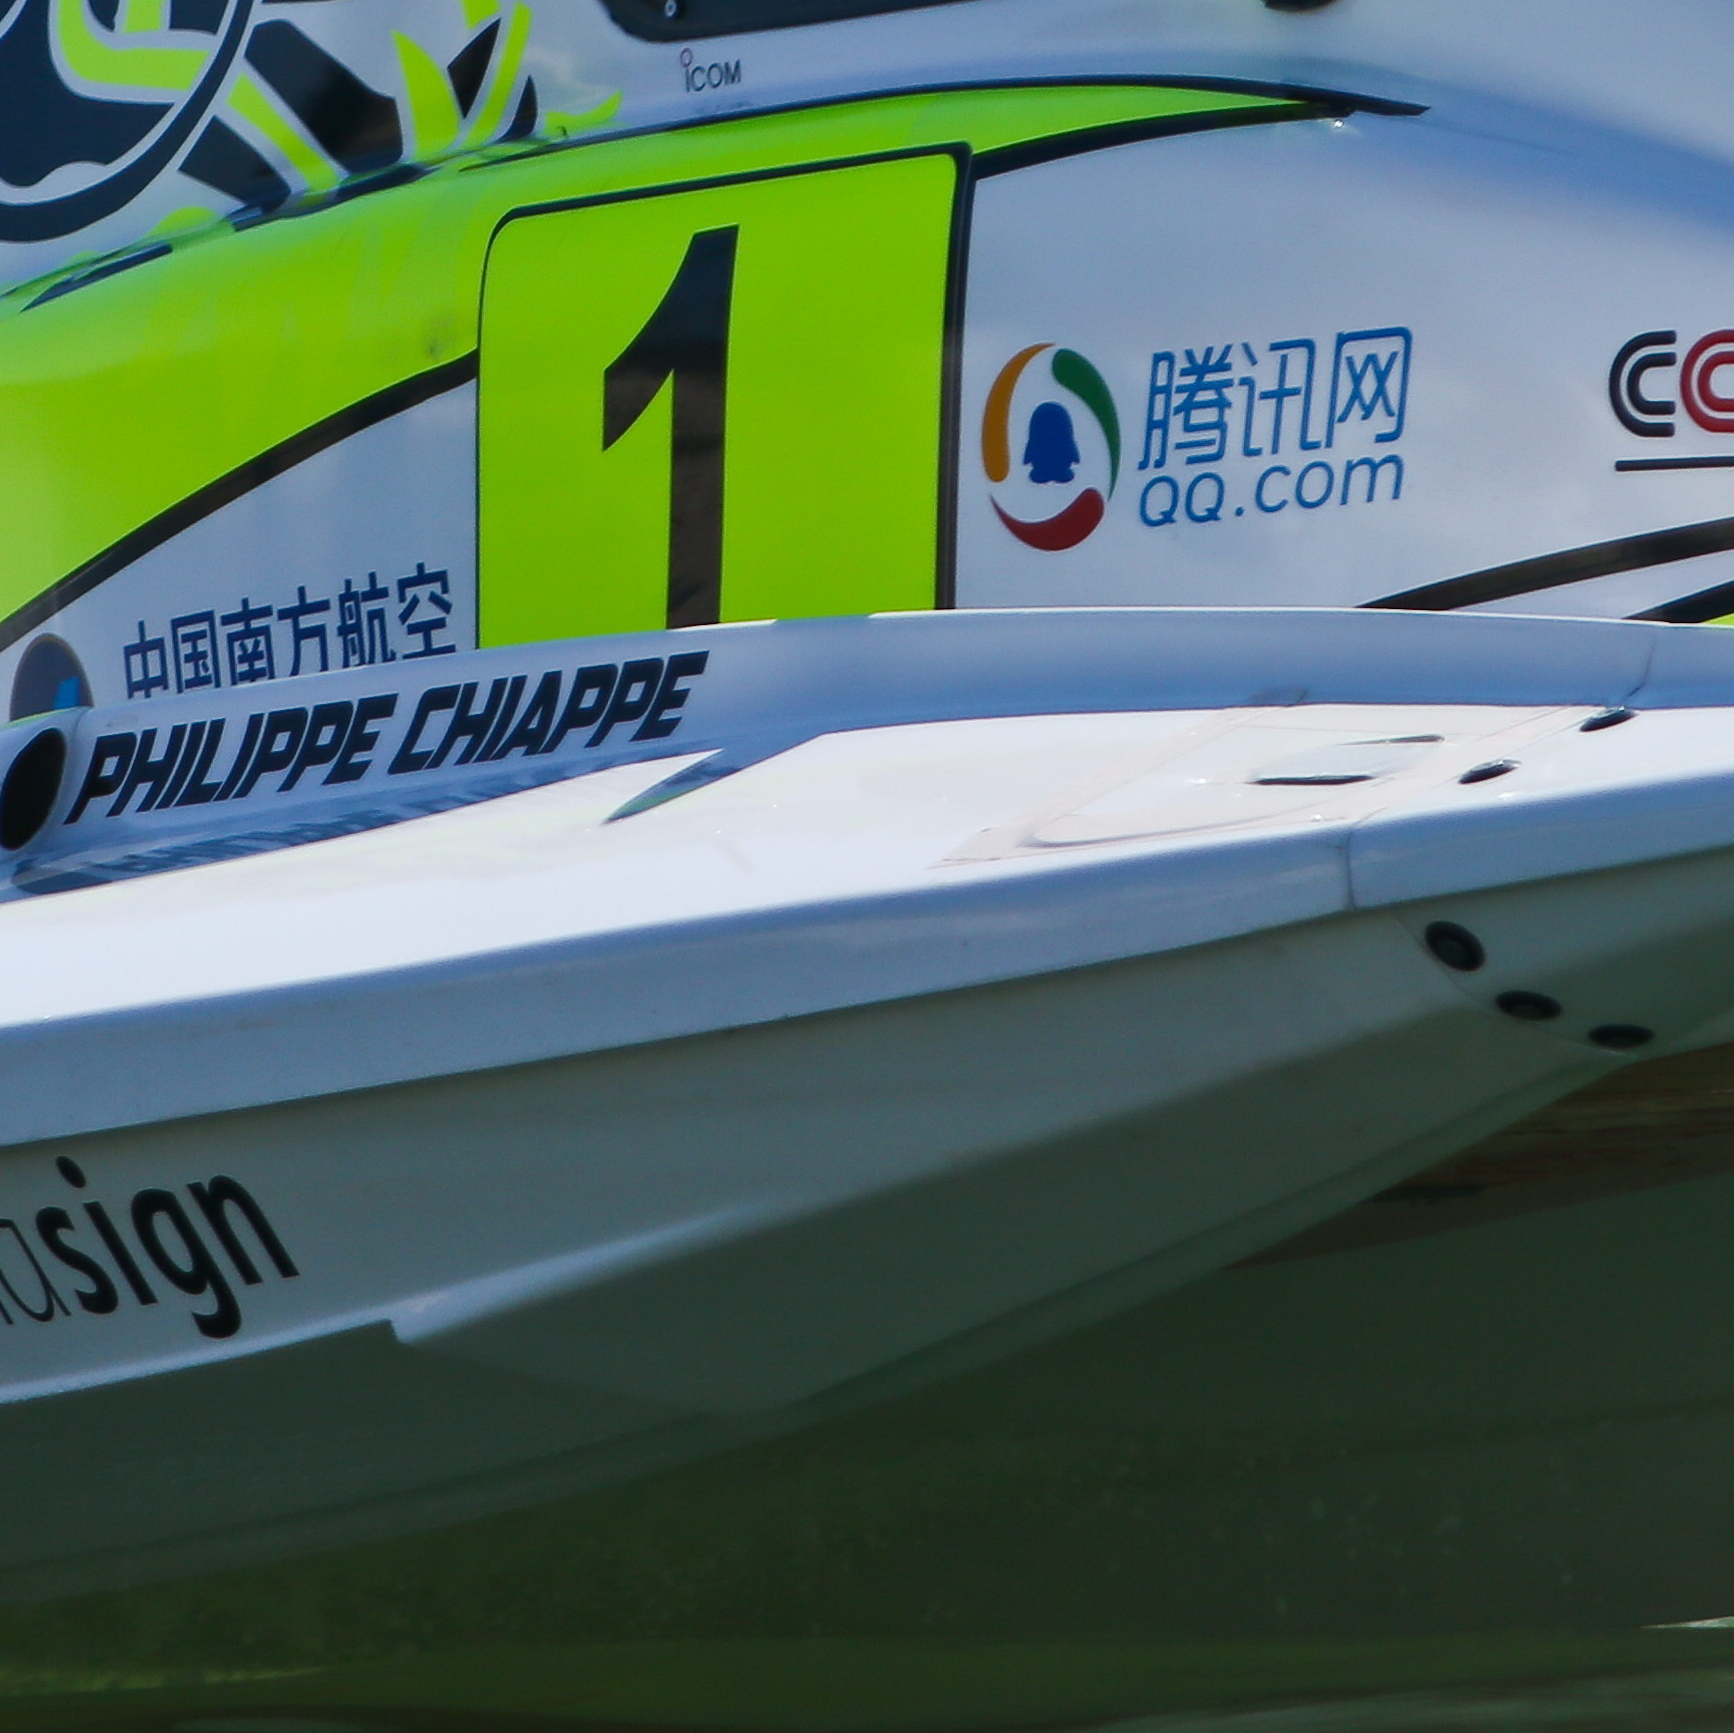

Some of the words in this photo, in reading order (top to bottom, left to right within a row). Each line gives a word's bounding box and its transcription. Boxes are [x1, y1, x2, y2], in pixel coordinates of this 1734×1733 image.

[604, 223, 739, 629] 1
[1137, 326, 1413, 471] 腾讯网
[1138, 453, 1403, 527] QQ.com
[123, 562, 456, 699] 中国南方航空
[63, 693, 397, 824] PHILIPPE
[388, 651, 709, 776] CHIAPPE
